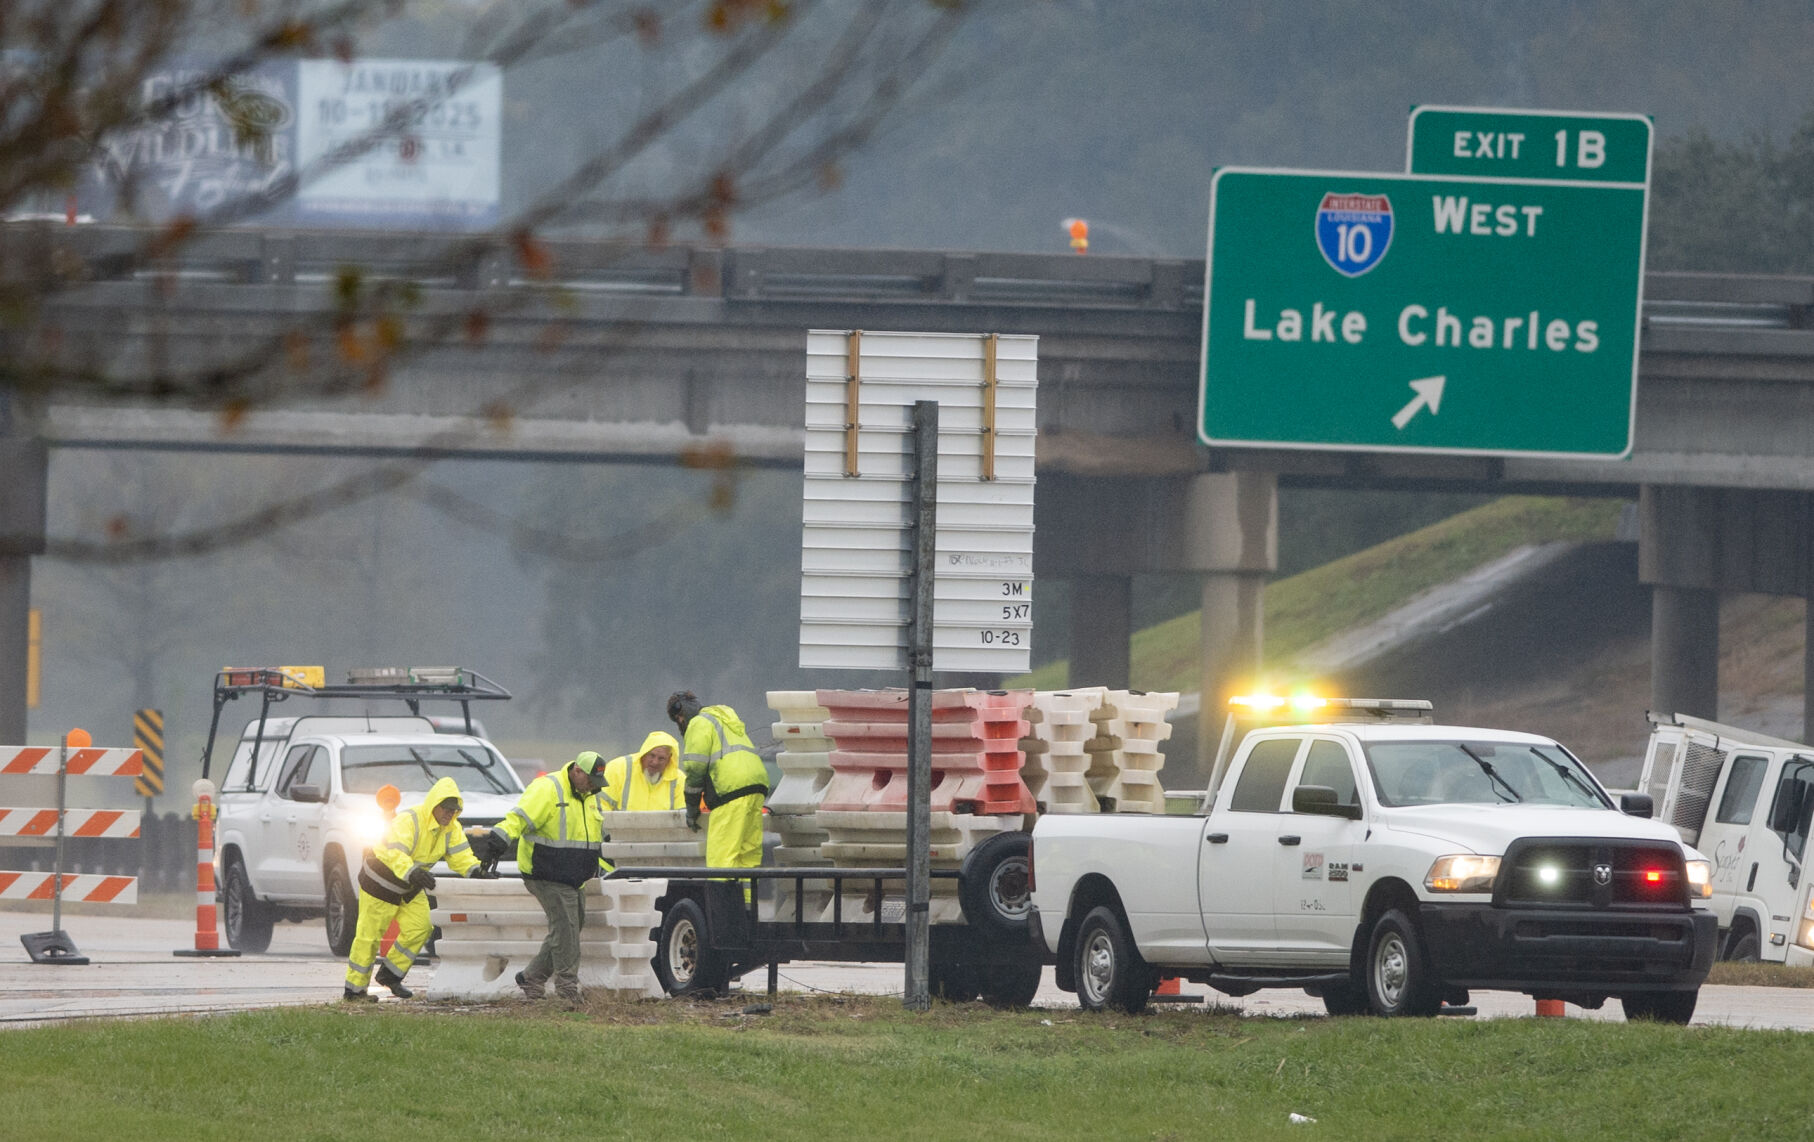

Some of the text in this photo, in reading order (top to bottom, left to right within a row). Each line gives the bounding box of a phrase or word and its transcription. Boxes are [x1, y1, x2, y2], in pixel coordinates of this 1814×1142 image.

[1453, 130, 1606, 169] EXIT 1B
[1328, 199, 1382, 212] INTERSTATE
[1327, 212, 1382, 224] LOUISIANA
[1432, 195, 1543, 237] WEST
[1336, 224, 1373, 264] 10
[1244, 299, 1599, 352] Lake Charles
[1002, 582, 1023, 596] 3M
[981, 630, 1020, 646] 10-23
[1328, 862, 1349, 870] RAM
